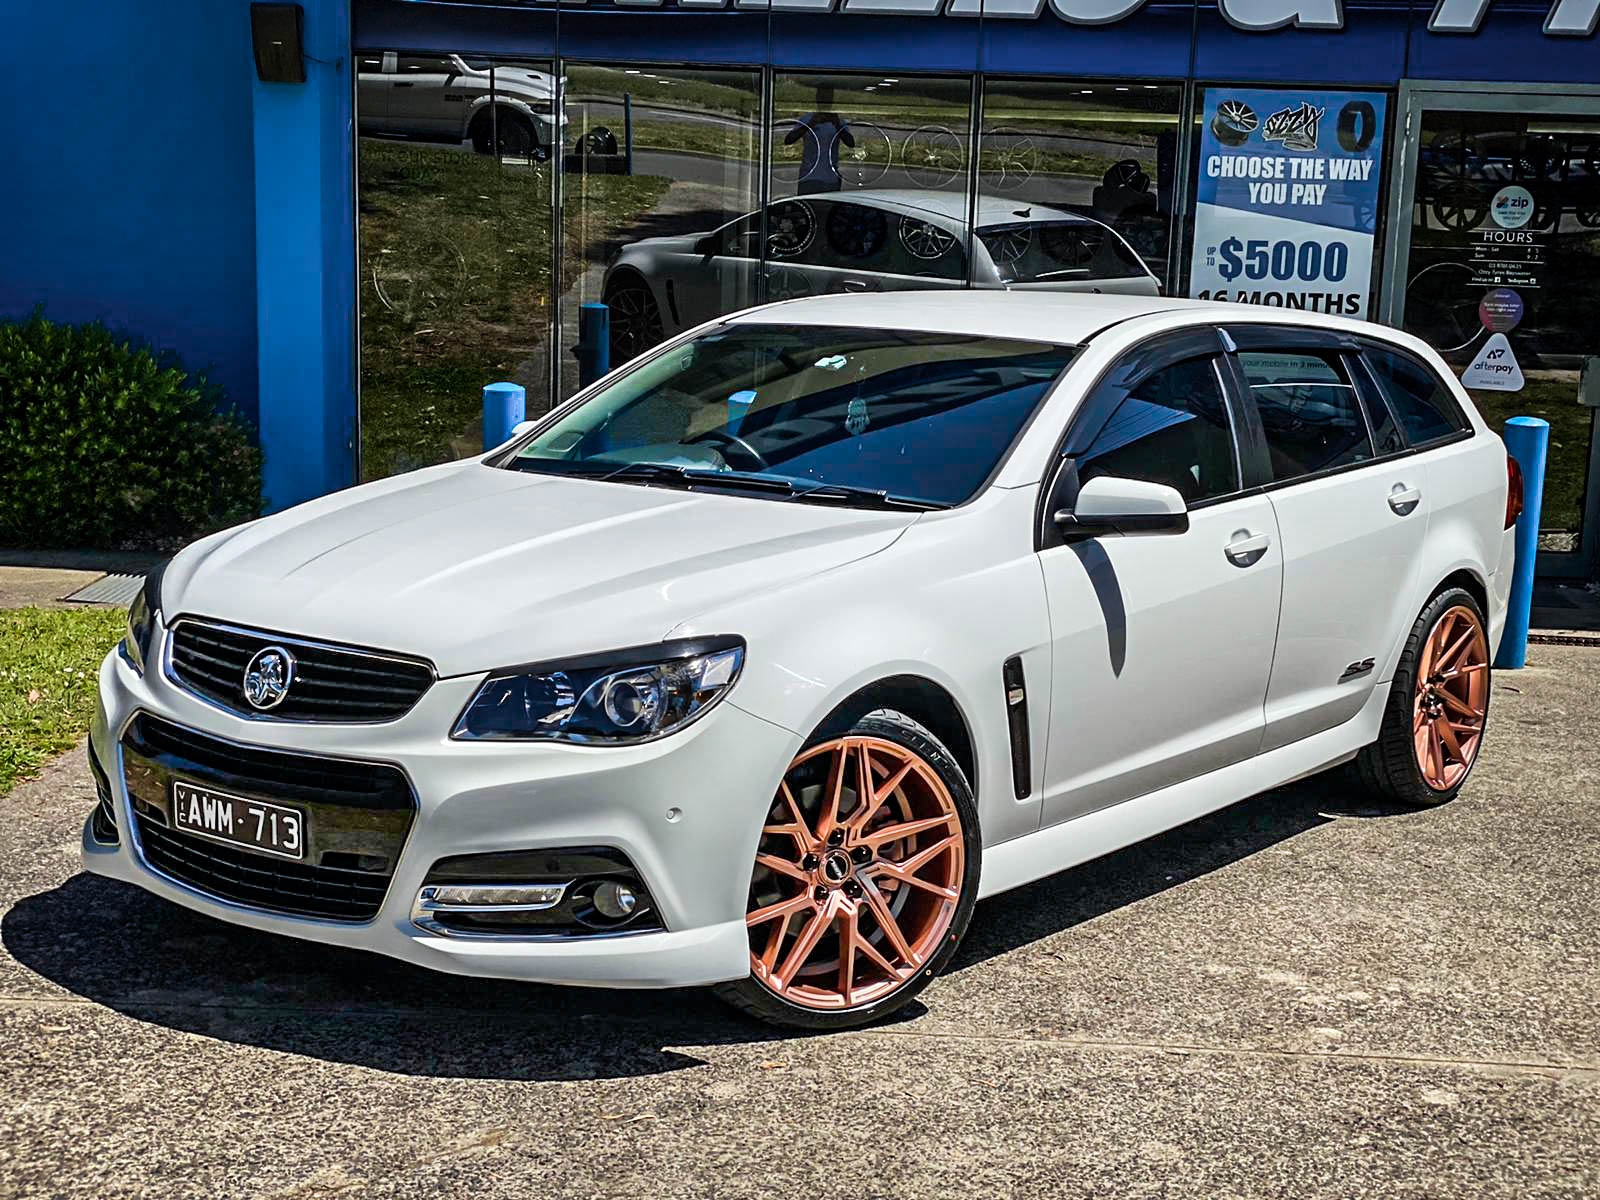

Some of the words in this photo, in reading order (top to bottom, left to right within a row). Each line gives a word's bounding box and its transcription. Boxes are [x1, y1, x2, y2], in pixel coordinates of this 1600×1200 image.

[1207, 156, 1285, 178] CHOOSE
[1289, 158, 1325, 179] THE
[1328, 159, 1373, 181] WAY
[1248, 183, 1288, 205] YOU
[1291, 184, 1327, 205] PAY
[1511, 197, 1528, 208] zip
[1484, 232, 1533, 243] HOURS
[1206, 247, 1217, 256] UP
[1218, 236, 1349, 282] $5000
[1206, 257, 1216, 266] TO
[1235, 291, 1361, 314] MONTHS
[1474, 361, 1514, 374] afterpay
[178, 790, 187, 823] VIC
